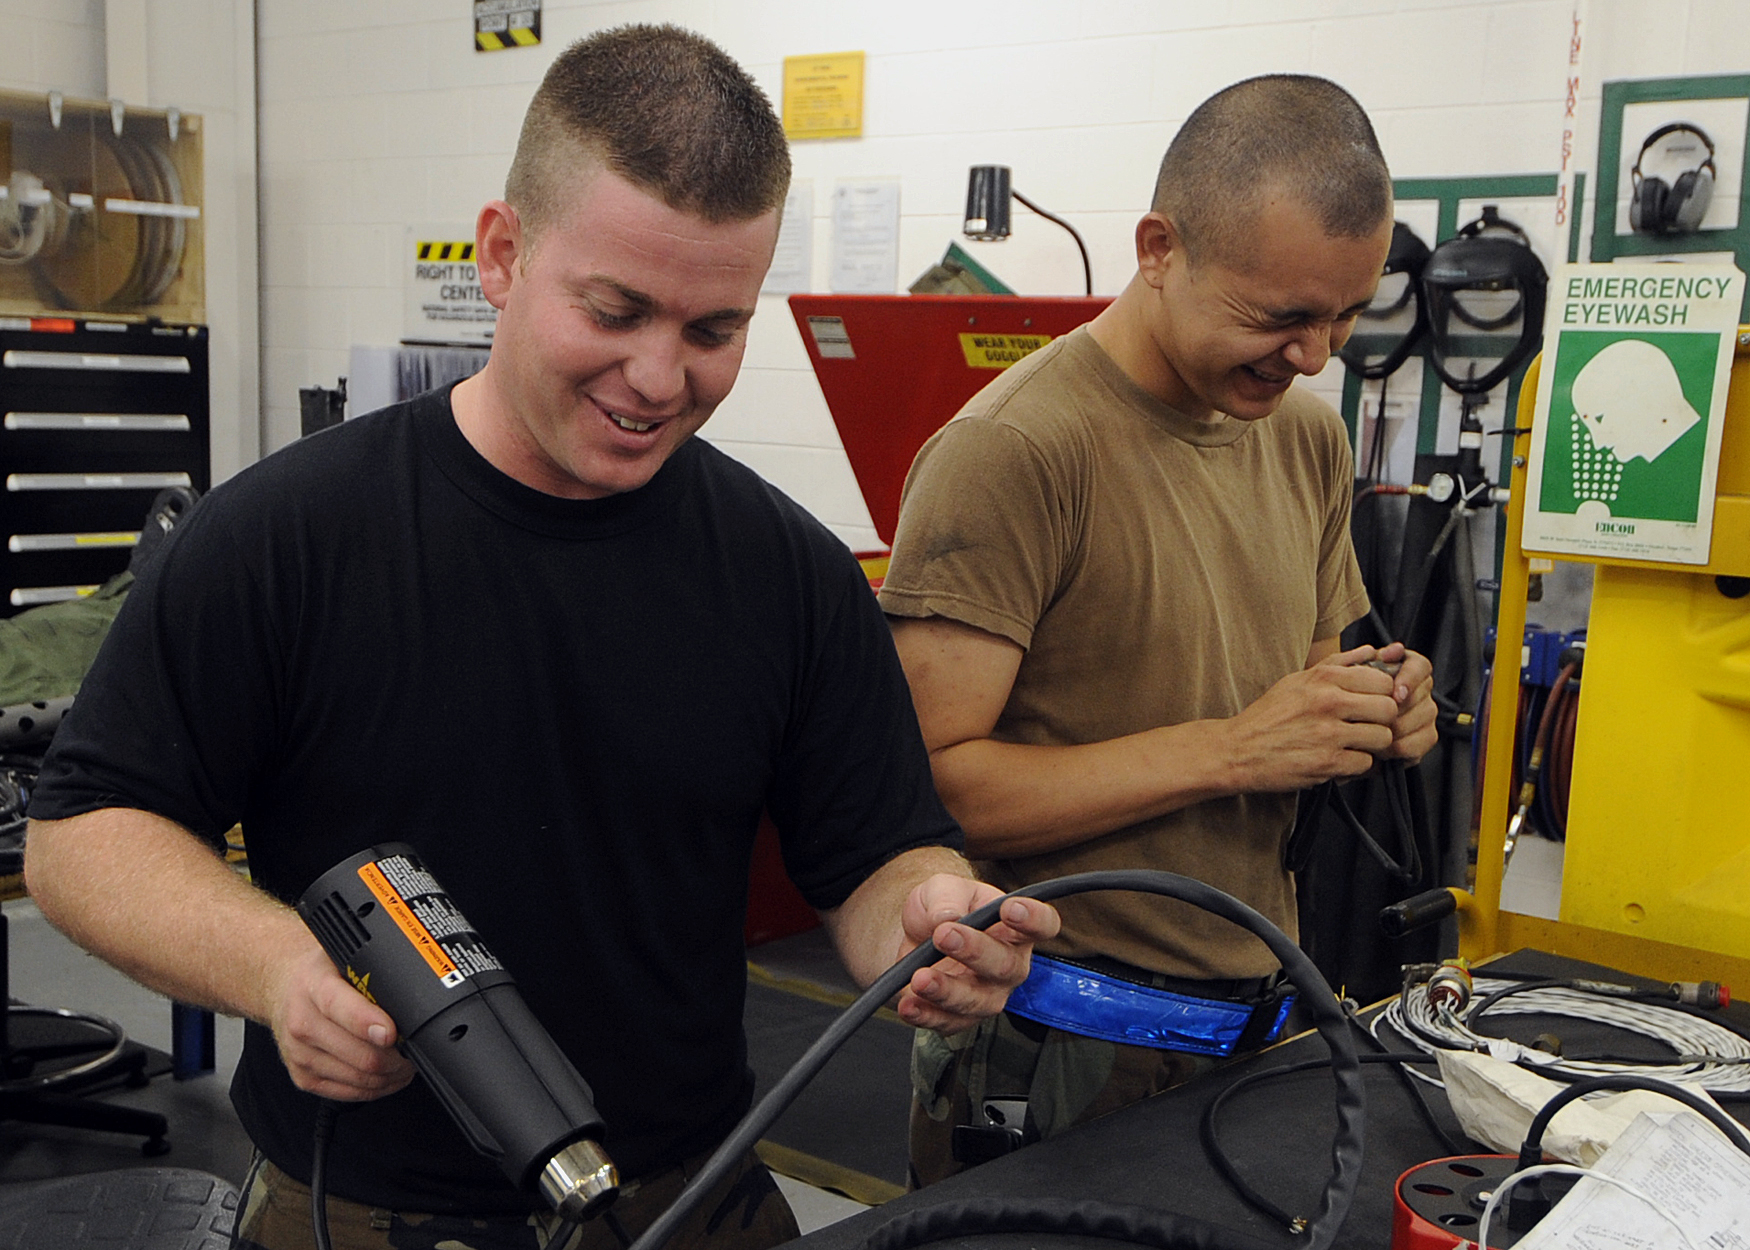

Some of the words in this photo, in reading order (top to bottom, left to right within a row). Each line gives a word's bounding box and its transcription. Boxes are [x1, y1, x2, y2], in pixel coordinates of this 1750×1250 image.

[416, 264, 454, 280] RIGHT
[459, 264, 476, 281] TO
[440, 285, 486, 300] CENTE
[1567, 277, 1731, 299] EMERGENCY
[1563, 303, 1688, 325] EYEWASH
[973, 337, 1006, 348] WEAR
[1010, 339, 1041, 350] YOUR
